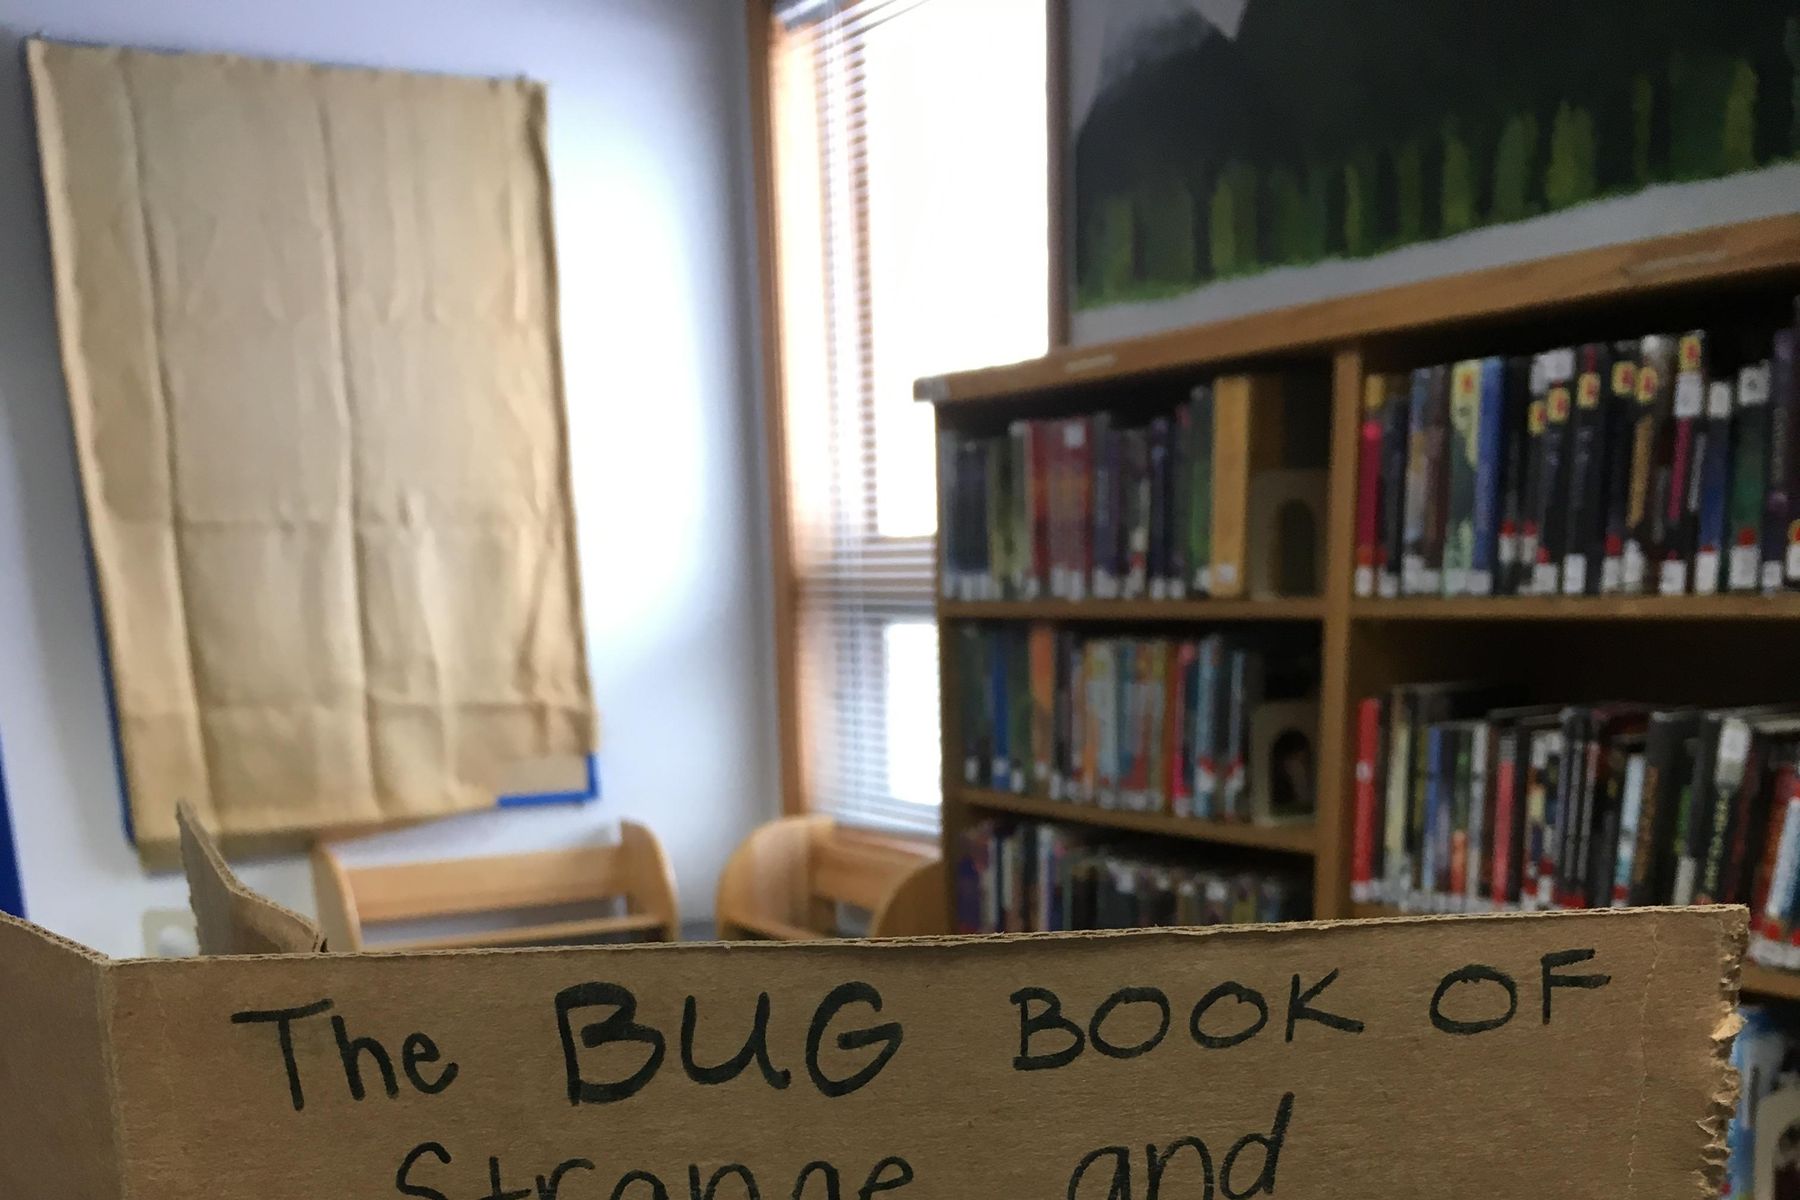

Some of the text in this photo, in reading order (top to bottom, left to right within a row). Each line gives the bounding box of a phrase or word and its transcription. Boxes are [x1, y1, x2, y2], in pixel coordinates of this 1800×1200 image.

[231, 947, 1612, 1112] The BUG BOOK OF
